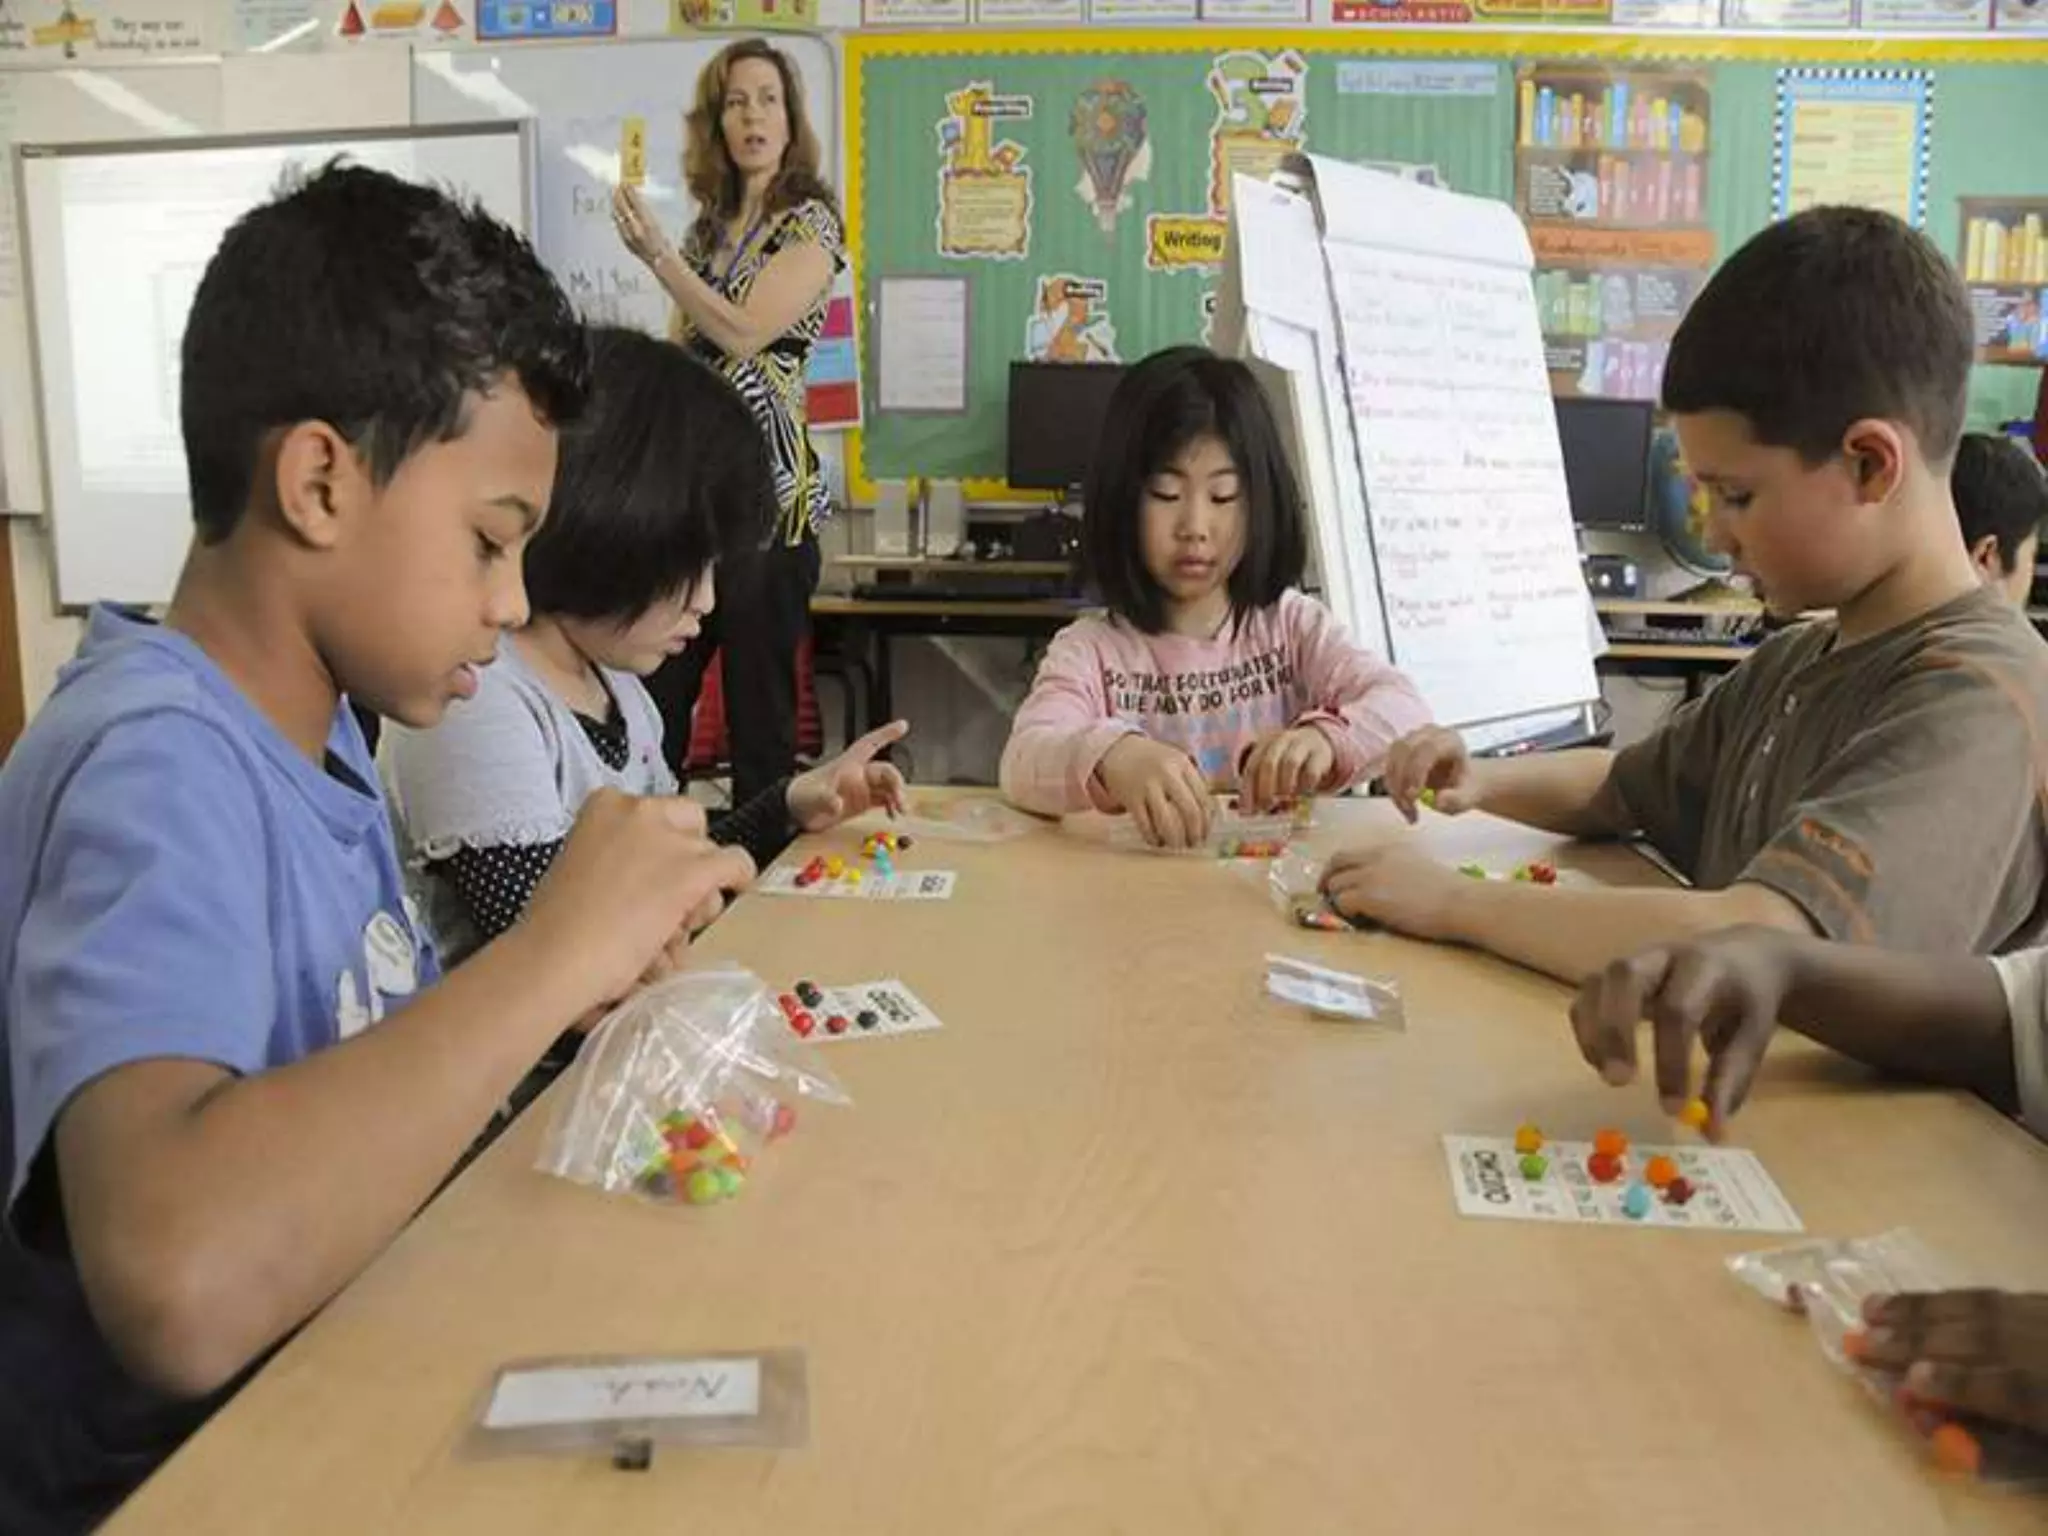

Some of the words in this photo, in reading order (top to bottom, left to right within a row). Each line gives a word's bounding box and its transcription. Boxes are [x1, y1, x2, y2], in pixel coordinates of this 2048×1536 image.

[1164, 230, 1222, 253] Writing
[1132, 672, 1170, 695] THAT
[1200, 690, 1222, 711] DO
